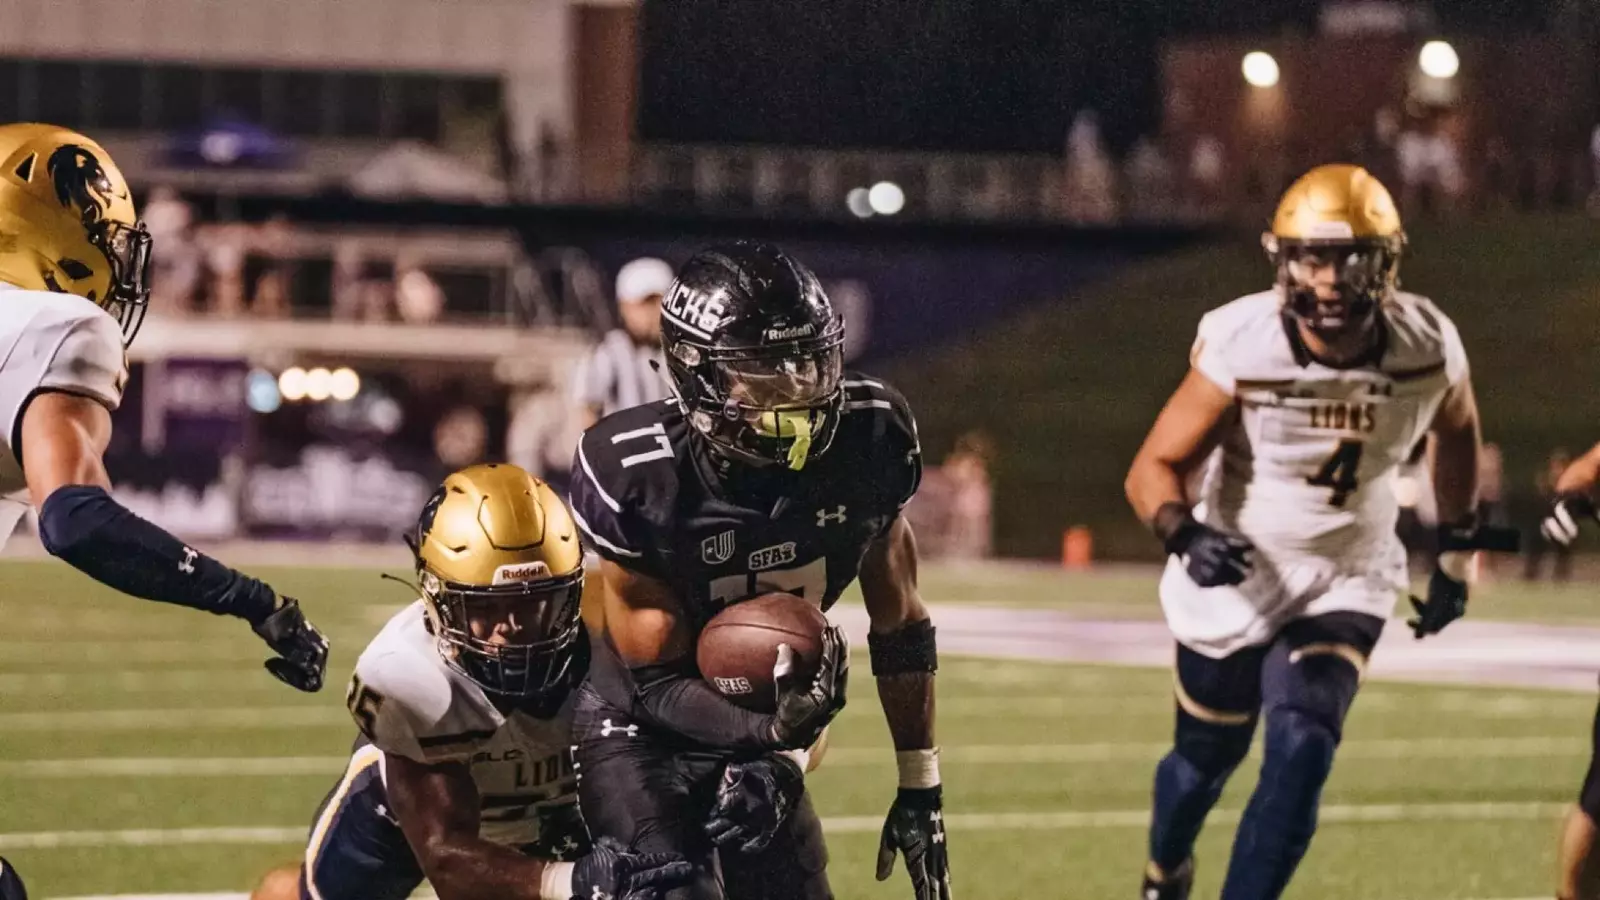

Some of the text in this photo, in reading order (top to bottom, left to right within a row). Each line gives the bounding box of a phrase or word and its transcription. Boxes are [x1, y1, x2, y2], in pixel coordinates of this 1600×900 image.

[768, 324, 812, 340] Riddell
[1309, 402, 1377, 434] LIONS
[610, 422, 676, 468] 17
[1306, 439, 1364, 507] 4
[750, 546, 785, 569] SFA
[502, 565, 545, 580] Riddell
